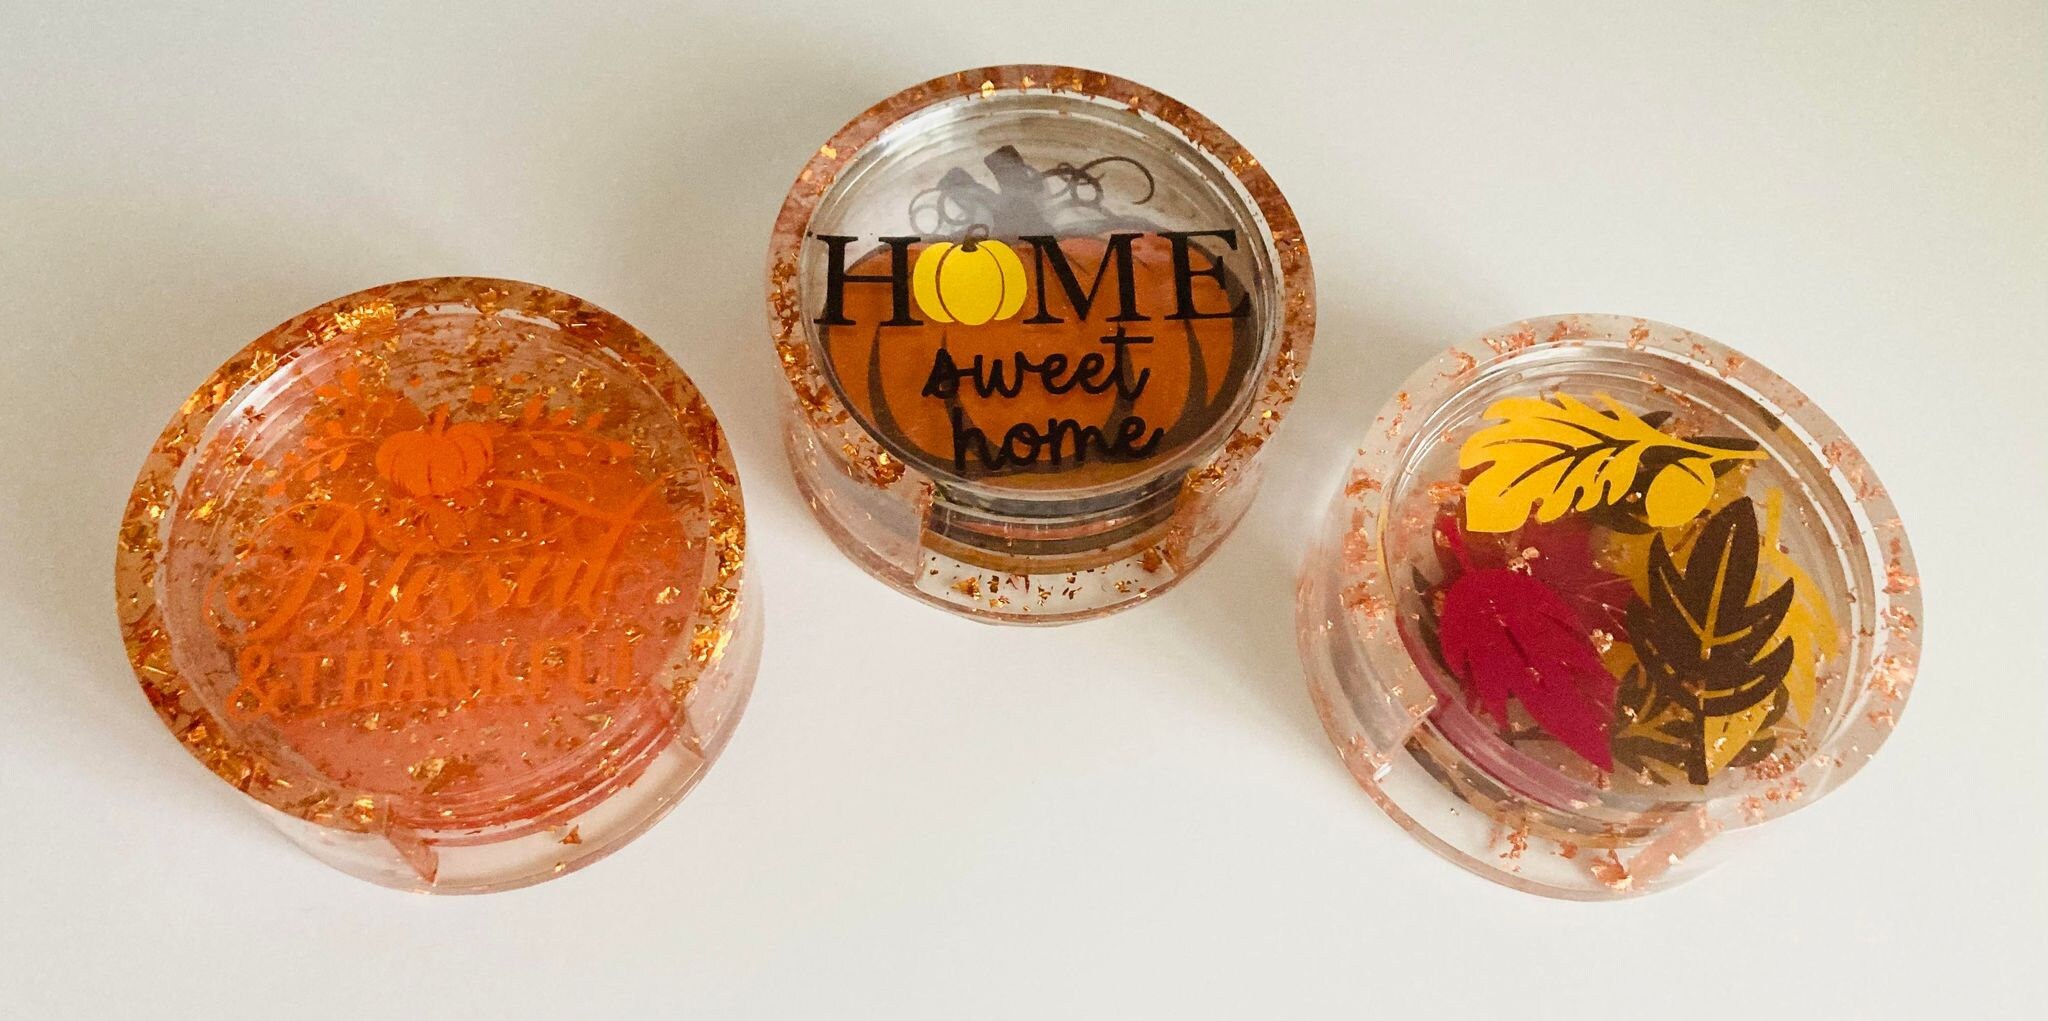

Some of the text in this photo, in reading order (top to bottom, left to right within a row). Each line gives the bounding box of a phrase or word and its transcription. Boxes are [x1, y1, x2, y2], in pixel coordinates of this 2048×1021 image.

[813, 224, 1252, 327] HOME
[922, 327, 1155, 399] sweet
[951, 409, 1166, 472] home
[203, 474, 682, 640] Blessed
